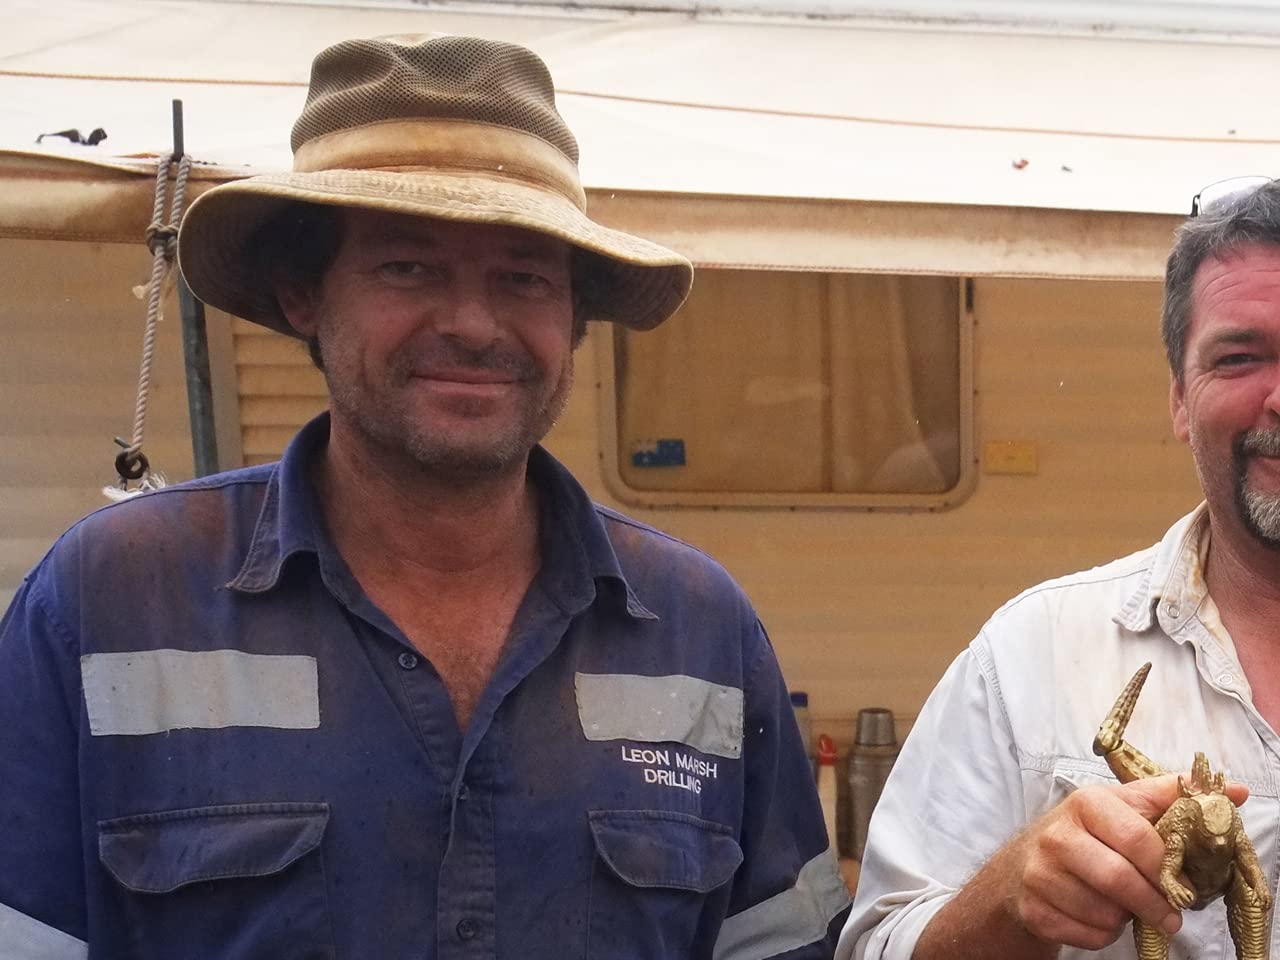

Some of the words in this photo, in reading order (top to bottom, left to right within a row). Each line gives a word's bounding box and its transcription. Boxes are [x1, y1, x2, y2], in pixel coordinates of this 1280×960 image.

[621, 746, 670, 766] LEON
[676, 752, 718, 779] MARSH
[644, 768, 702, 794] DRILLING
